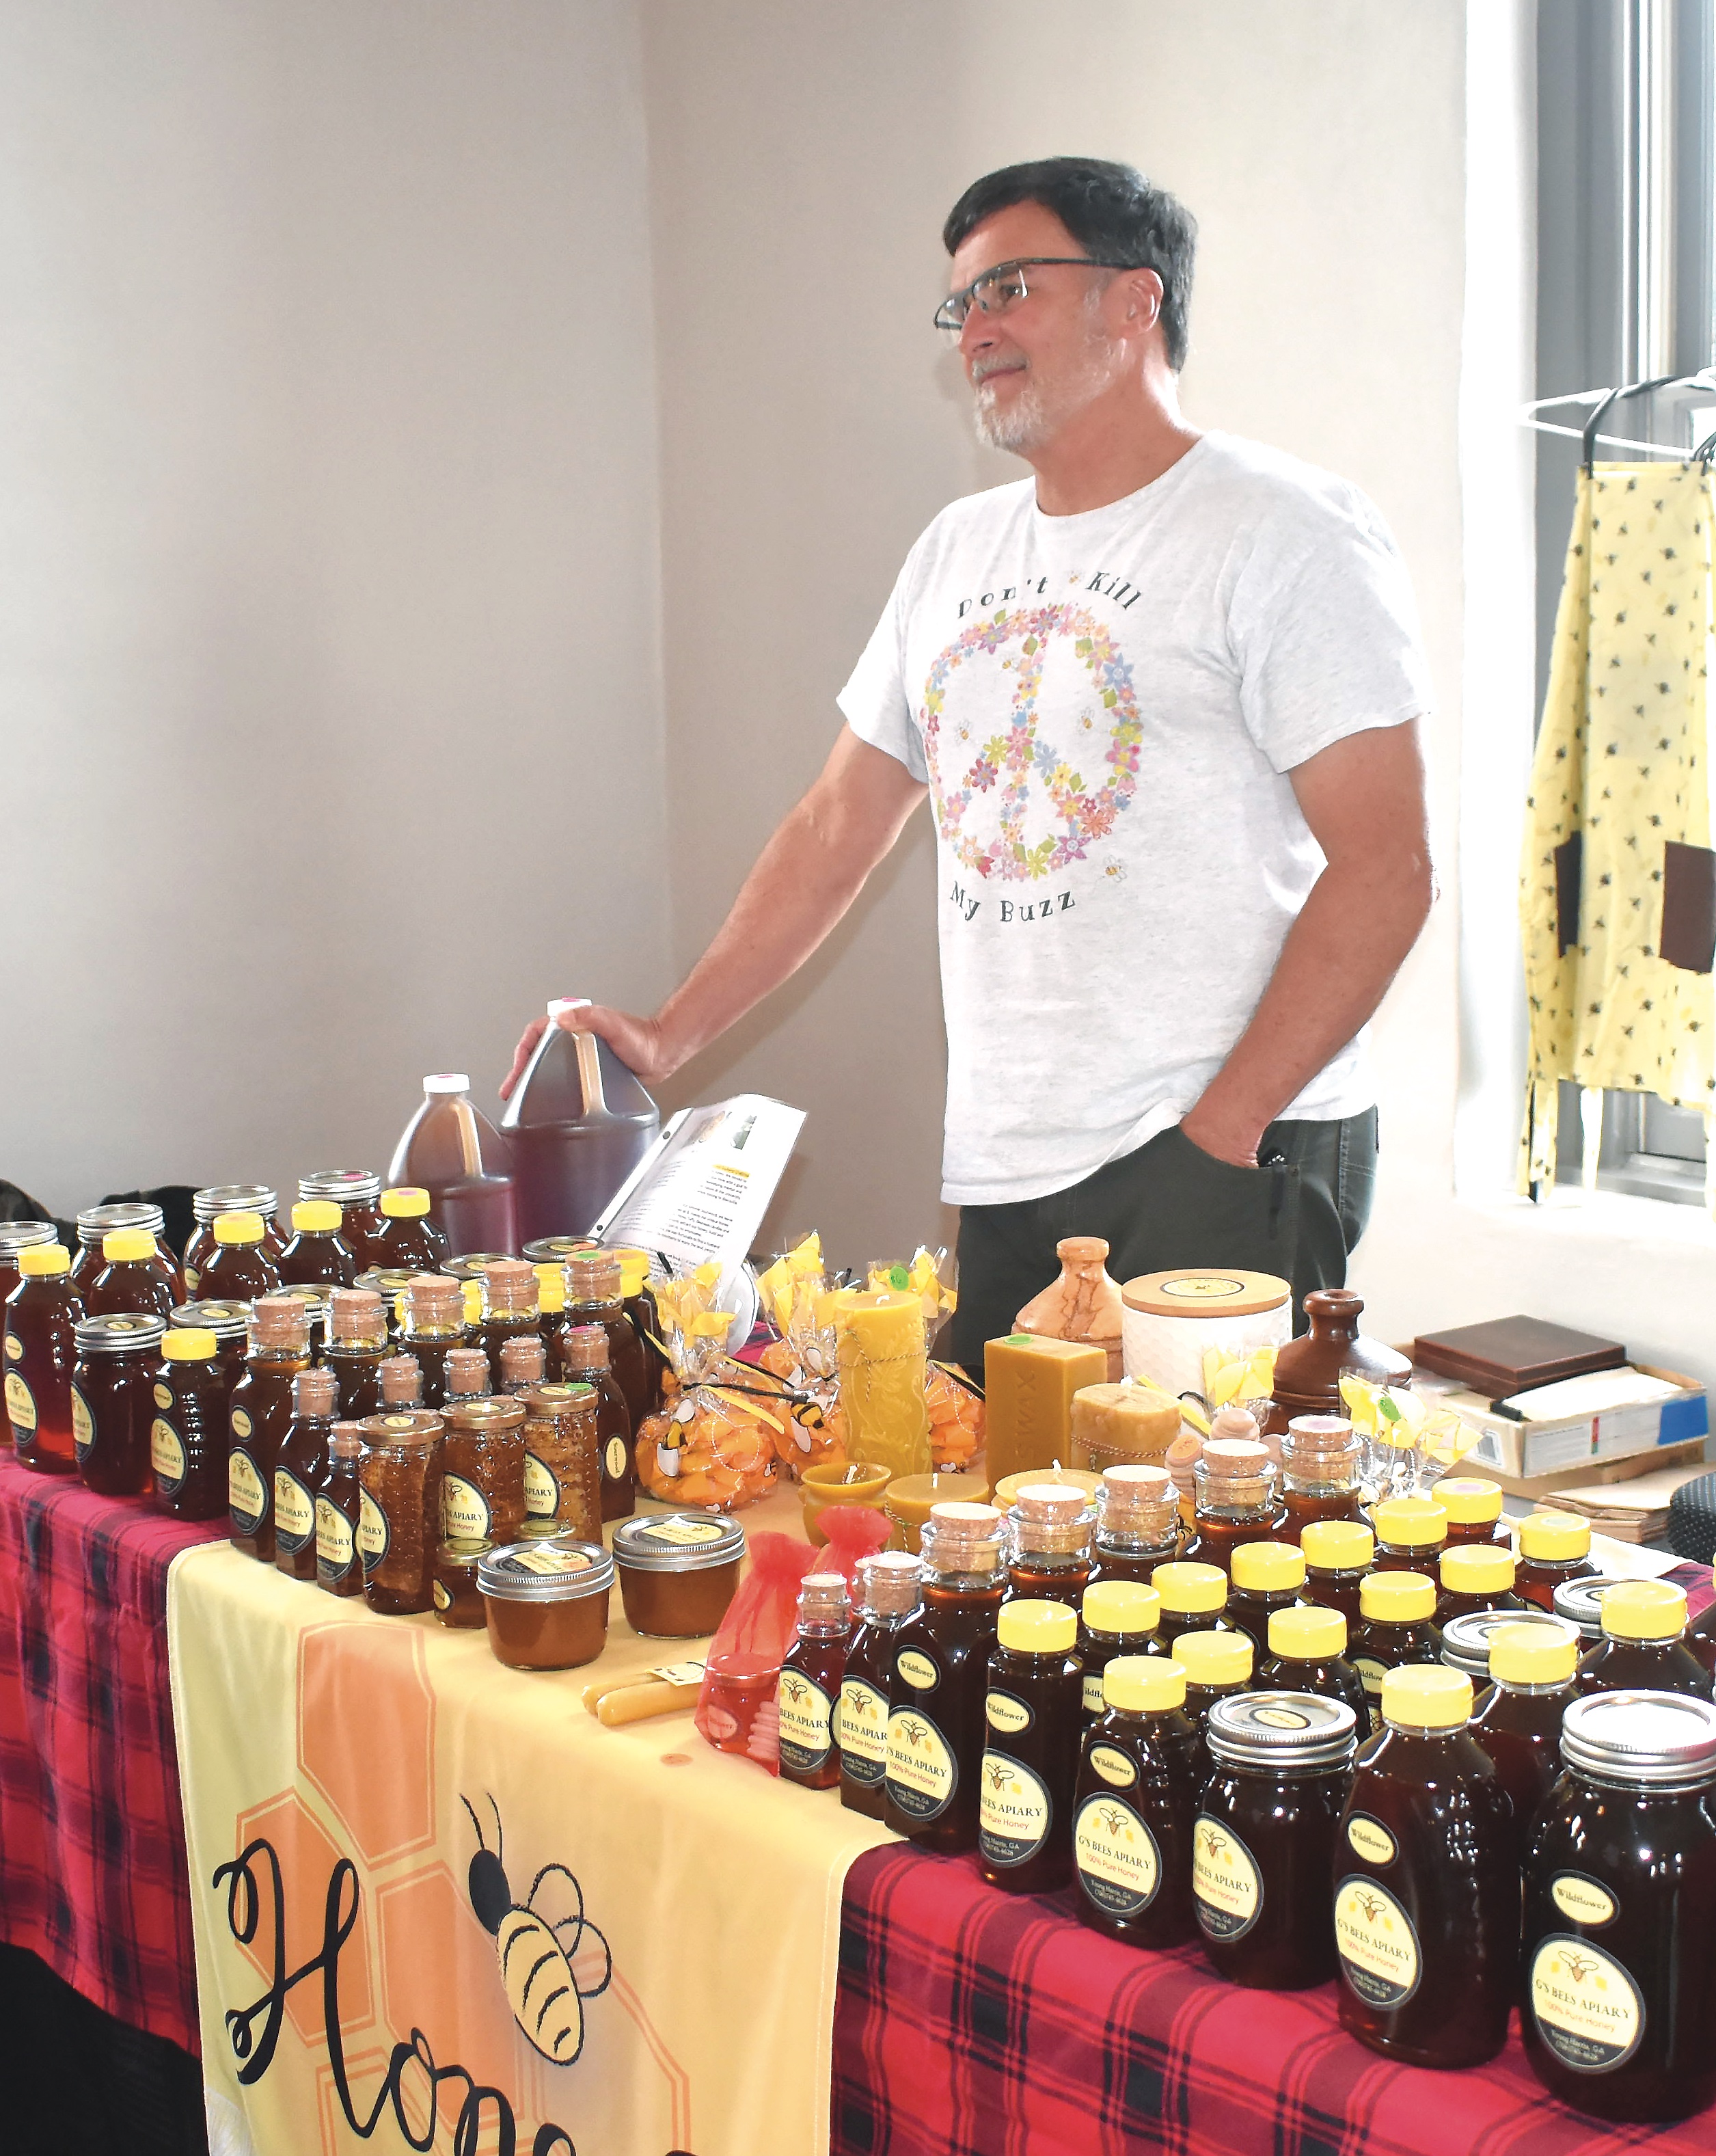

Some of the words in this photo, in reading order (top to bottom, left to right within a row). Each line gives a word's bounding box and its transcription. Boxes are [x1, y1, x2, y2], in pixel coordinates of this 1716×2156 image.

[957, 576, 1048, 619] Don't
[1085, 571, 1141, 610] Kill
[949, 880, 981, 921] My
[999, 891, 1076, 922] Buzz
[901, 1660, 934, 1678] Wildflower
[842, 1716, 859, 1732] BEES
[860, 1727, 888, 1740] APIAR
[895, 1750, 913, 1765] BEES
[914, 1759, 947, 1777] APIARY
[1093, 1755, 1131, 1776] Wildflower
[998, 1803, 1043, 1818] APIARY
[1003, 1819, 1030, 1831] Honey
[1352, 1828, 1390, 1851] Wildflower
[1078, 1835, 1091, 1848] G'S
[1092, 1840, 1112, 1857] BEES
[1114, 1850, 1151, 1870] APIARY
[1118, 1866, 1140, 1882] Honey
[1214, 1873, 1252, 1893] APIARY
[1557, 1887, 1607, 1911] Wildflower
[1350, 1926, 1370, 1944] BEES
[1372, 1939, 1411, 1961] APIARY
[1551, 1986, 1576, 2006] BEES
[1580, 1999, 1631, 2019] APIARY
[1585, 2018, 1615, 2033] Honey
